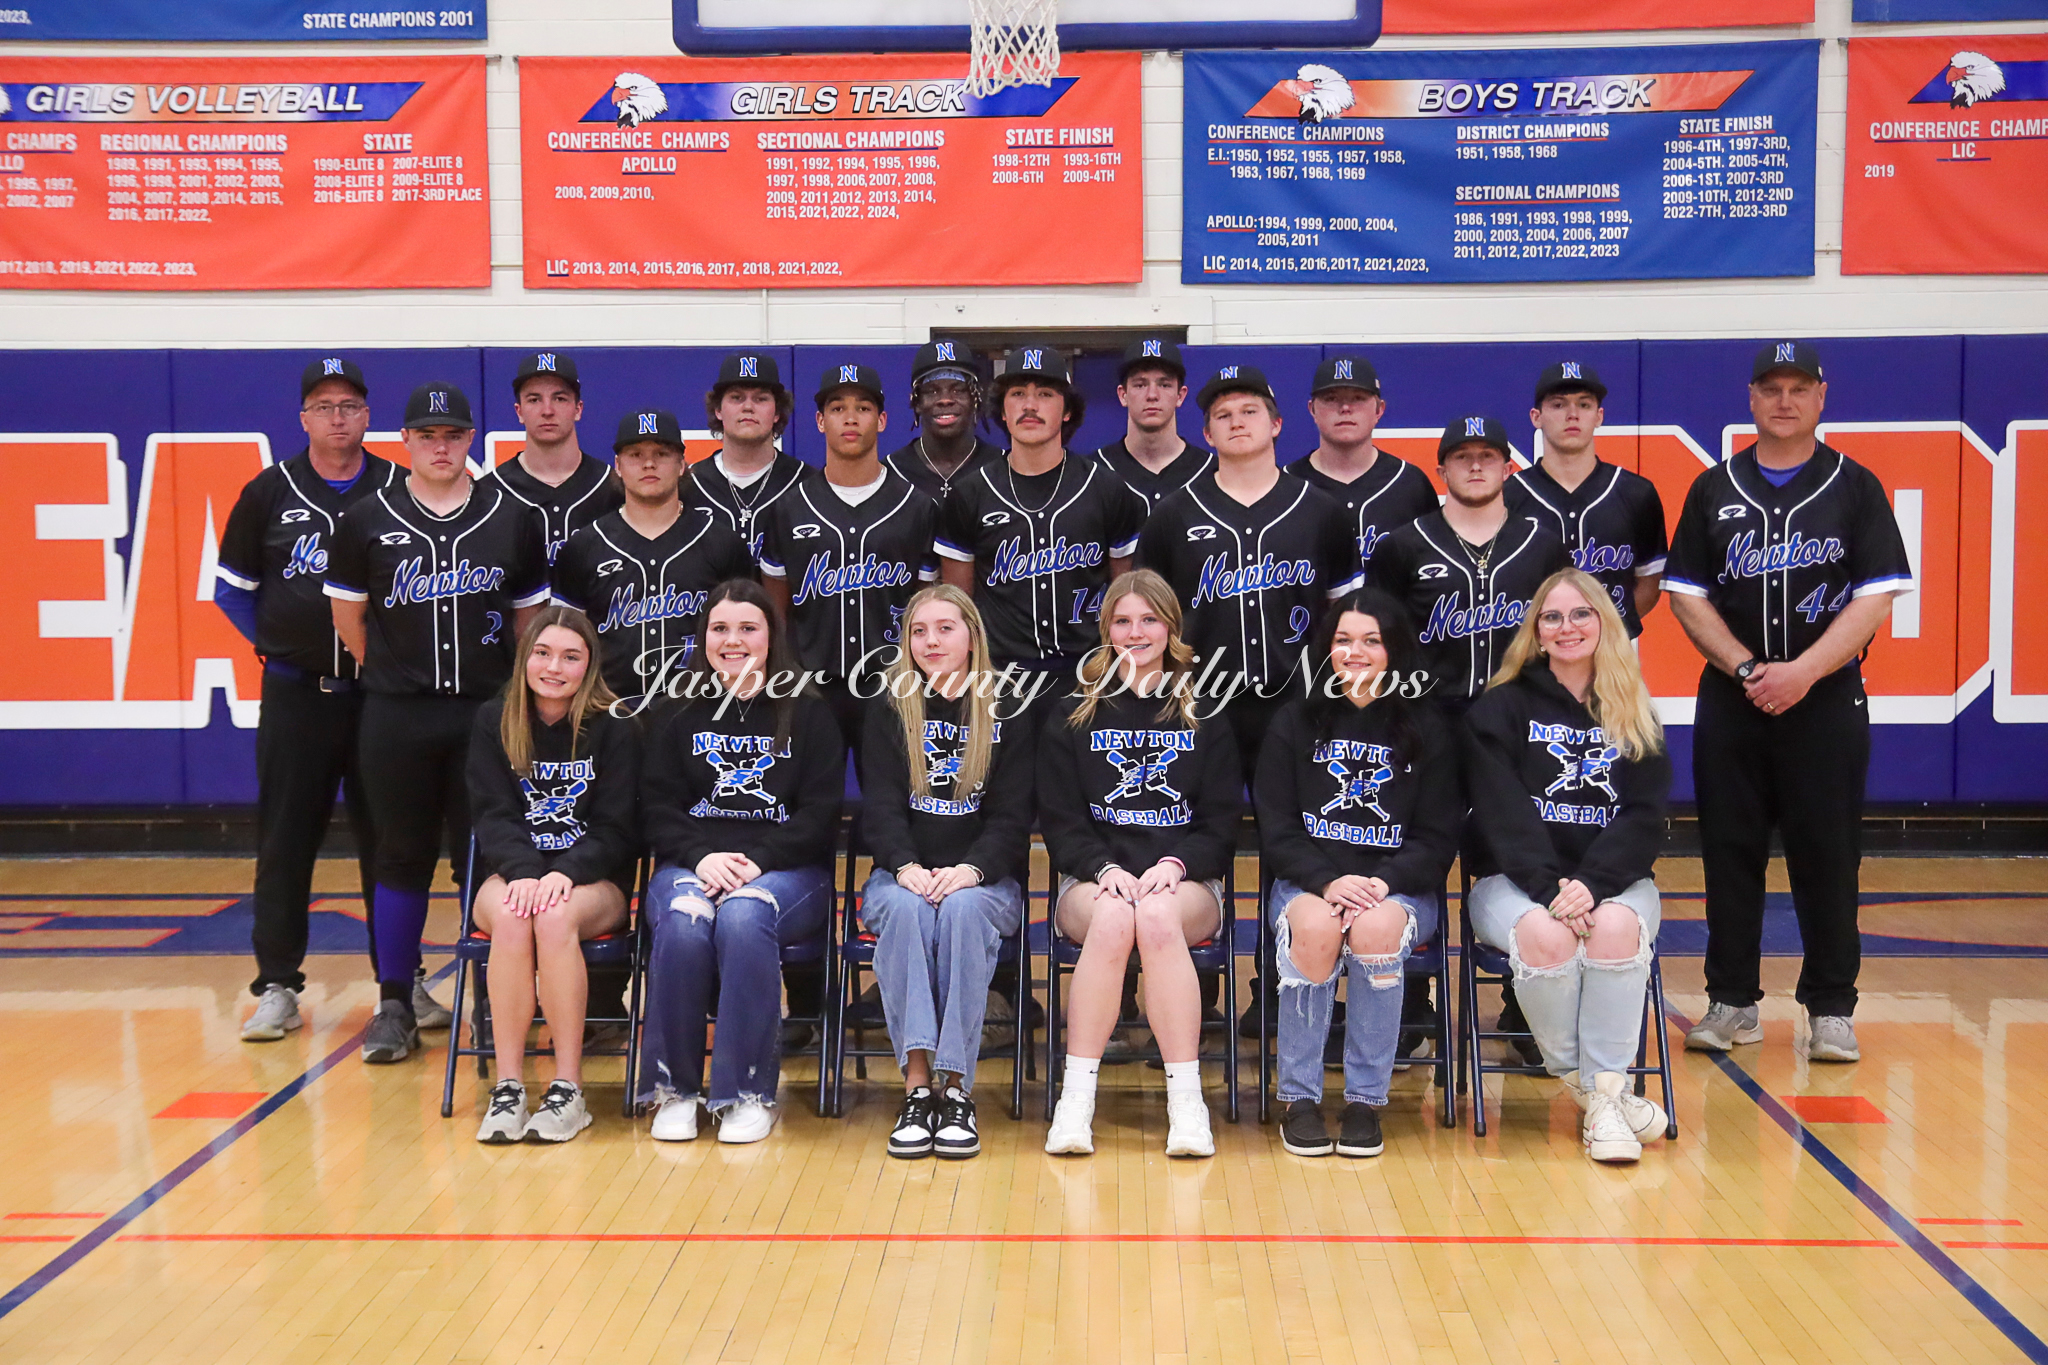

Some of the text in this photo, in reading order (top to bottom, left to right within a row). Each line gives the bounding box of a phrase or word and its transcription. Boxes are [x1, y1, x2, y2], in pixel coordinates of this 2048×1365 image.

[303, 11, 473, 29] STATE CHAMPIONS 2001
[26, 84, 364, 114] GIRLS VOLLEYBALL
[731, 84, 967, 114] GIRLS TRACK
[1418, 80, 1656, 112] BOYS TRACK
[1208, 124, 1384, 140] CONFERENCE CHAMPIONS
[1457, 123, 1609, 139] DISTRICT CHAMPIONS
[1680, 115, 1772, 135] STATE FINISH
[1870, 121, 1979, 139] CONFERENCE
[7, 133, 77, 150] CHAMPS
[101, 134, 287, 151] REGIONAL CHAMPIONS
[364, 134, 412, 150] STATE
[548, 132, 729, 148] CONFERENCE CHAMPS
[757, 130, 944, 149] SECTIONAL CHAMPIONS
[1006, 127, 1113, 145] STATE FINISH
[1456, 145, 1557, 160] 1951, 1958, 1968
[1664, 137, 1790, 153] 1996-4TH, 1997-3RD,
[1953, 142, 1975, 158] LIC
[377, 158, 384, 170] 8
[393, 156, 463, 169] 2007-ELITE 8
[622, 157, 676, 172] APOLLO
[766, 156, 939, 171] 1991, 1992, 1994, 1995, 1996,
[993, 153, 1121, 166] 1998-12TH 1993-16TH
[1266, 149, 1298, 163] 1952,
[1302, 150, 1333, 164] 1955,
[1337, 150, 1369, 164] 1957,
[1373, 151, 1405, 164] 1958,
[1729, 154, 1788, 167] 2005-4TH,
[905, 173, 936, 185] 2008,
[993, 170, 1114, 183] 2008-6TH 2009-4TH
[1230, 166, 1365, 180] 1963, 1967, 1968, 1969
[1663, 171, 1783, 187] 2006-1ST, 2007-3RD
[1865, 165, 1894, 177] 2019
[392, 173, 463, 186] 2009-ELITE 8
[766, 174, 833, 188] 1997, 1998,
[377, 190, 383, 201] 8
[392, 188, 482, 201] 2017-3RD PLACE
[555, 186, 587, 200] 2008,
[767, 191, 797, 204] 2009,
[869, 190, 936, 203] 2013, 2014,
[1456, 184, 1619, 201] SECTIONAL CHAMPIONS
[1663, 188, 1793, 204] 2009-10TH, 2012-2ND
[868, 206, 899, 219] 2024,
[1454, 210, 1632, 226] 1986, 1991, 1993, 1998, 1999,
[1664, 204, 1787, 218] 2022-7TH, 2023-3RD
[1294, 217, 1325, 231] 1999,
[1330, 218, 1361, 231] 2000,
[1366, 218, 1397, 232] 2004,
[1454, 227, 1629, 243] 2000, 2003, 2004, 2006, 2007
[547, 259, 640, 275] LIC 2013, 2014,
[1204, 256, 1298, 272] LIC 2014, 2015,
[936, 342, 956, 361] N
[1142, 340, 1162, 357] N
[1775, 343, 1795, 362] N
[323, 357, 345, 375] N
[537, 353, 556, 371] N
[740, 357, 758, 377] N
[1023, 349, 1042, 370] N
[839, 364, 858, 383] N
[1219, 365, 1239, 380] N
[1335, 360, 1353, 380] N
[1562, 361, 1583, 379] N
[429, 391, 449, 413] N
[638, 413, 658, 434] N
[1465, 417, 1485, 436] N
[987, 535, 1104, 587] Newton
[1717, 529, 1845, 584] Newton
[792, 550, 912, 606] Newton
[1191, 551, 1316, 609] Newton
[1068, 583, 1107, 624] 14
[481, 610, 503, 645] 2
[1283, 605, 1310, 643] 9
[1091, 729, 1195, 751] NEWTON
[1302, 811, 1403, 848] BASEBALL
